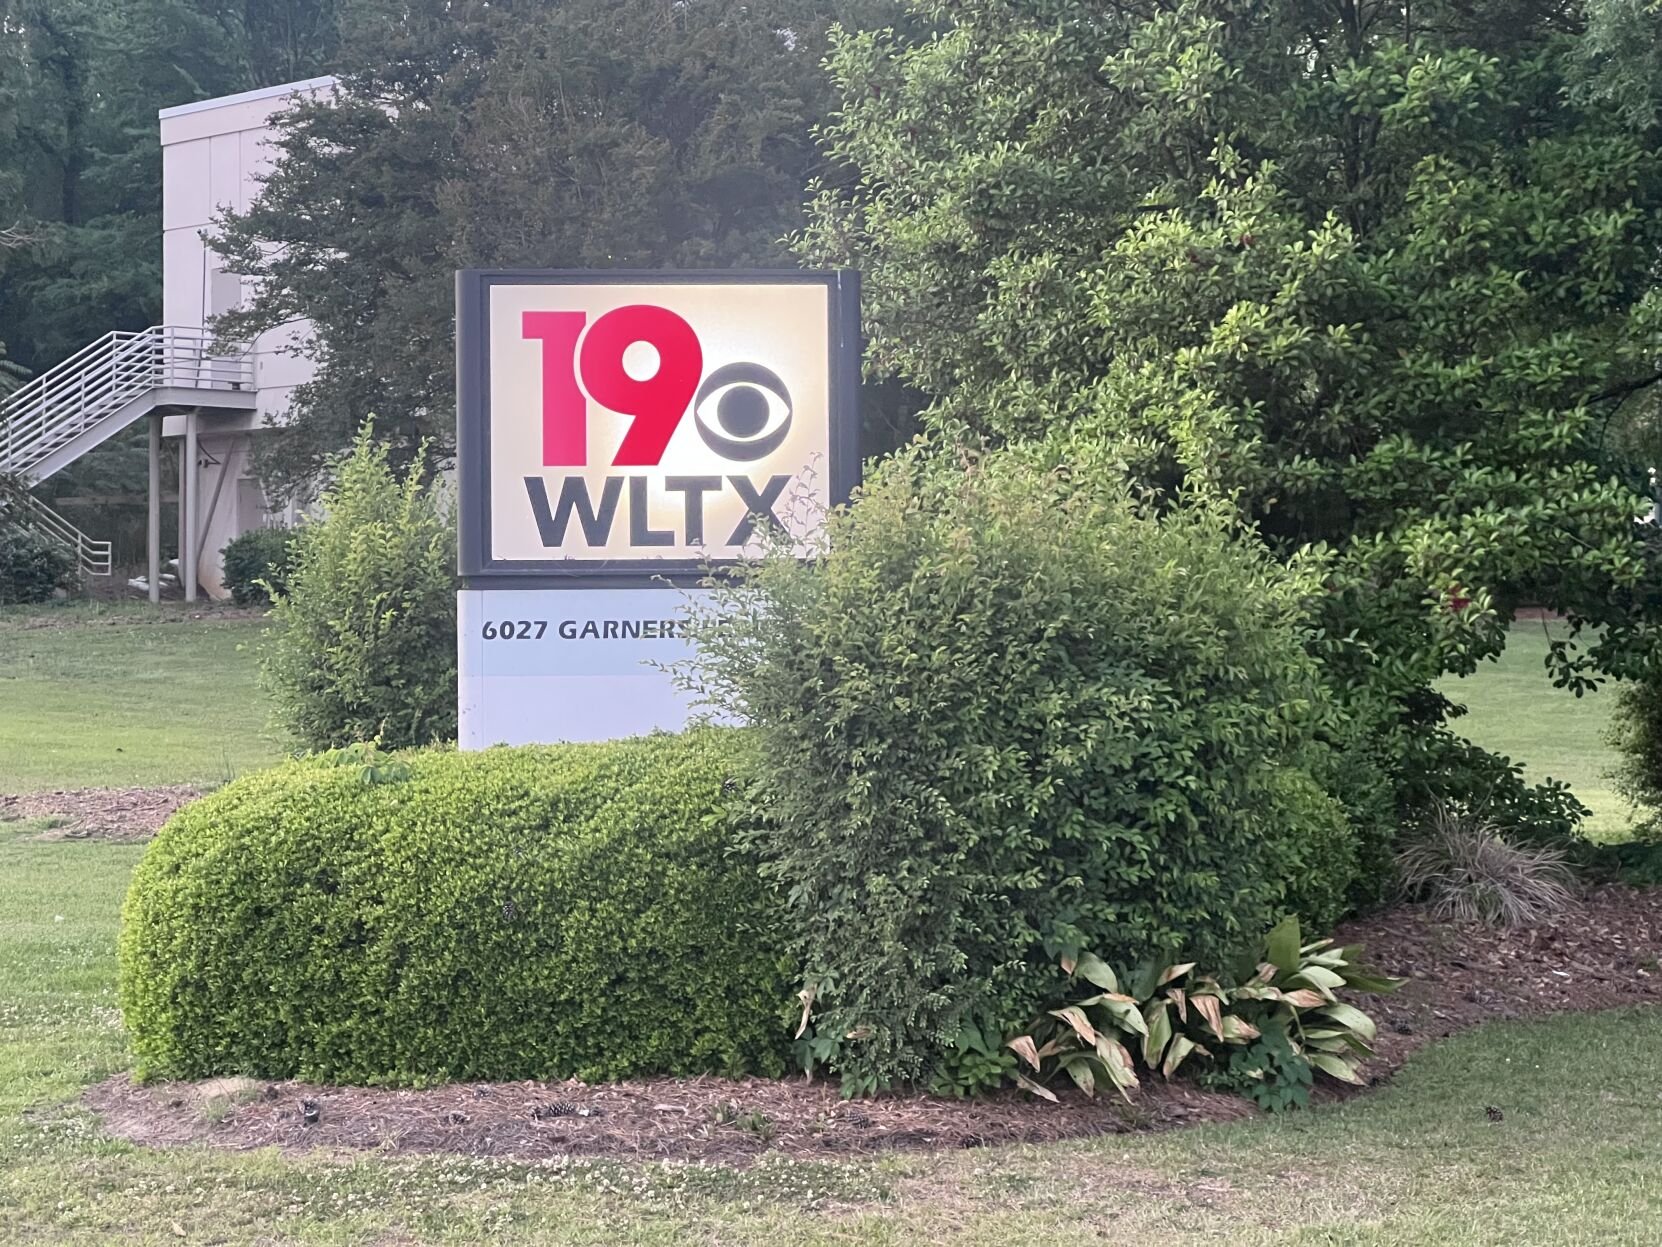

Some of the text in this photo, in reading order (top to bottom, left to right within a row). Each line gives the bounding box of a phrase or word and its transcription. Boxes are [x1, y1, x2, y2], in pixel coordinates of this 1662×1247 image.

[522, 304, 703, 467] 19
[523, 475, 793, 548] WLTX
[481, 620, 548, 640] 6027
